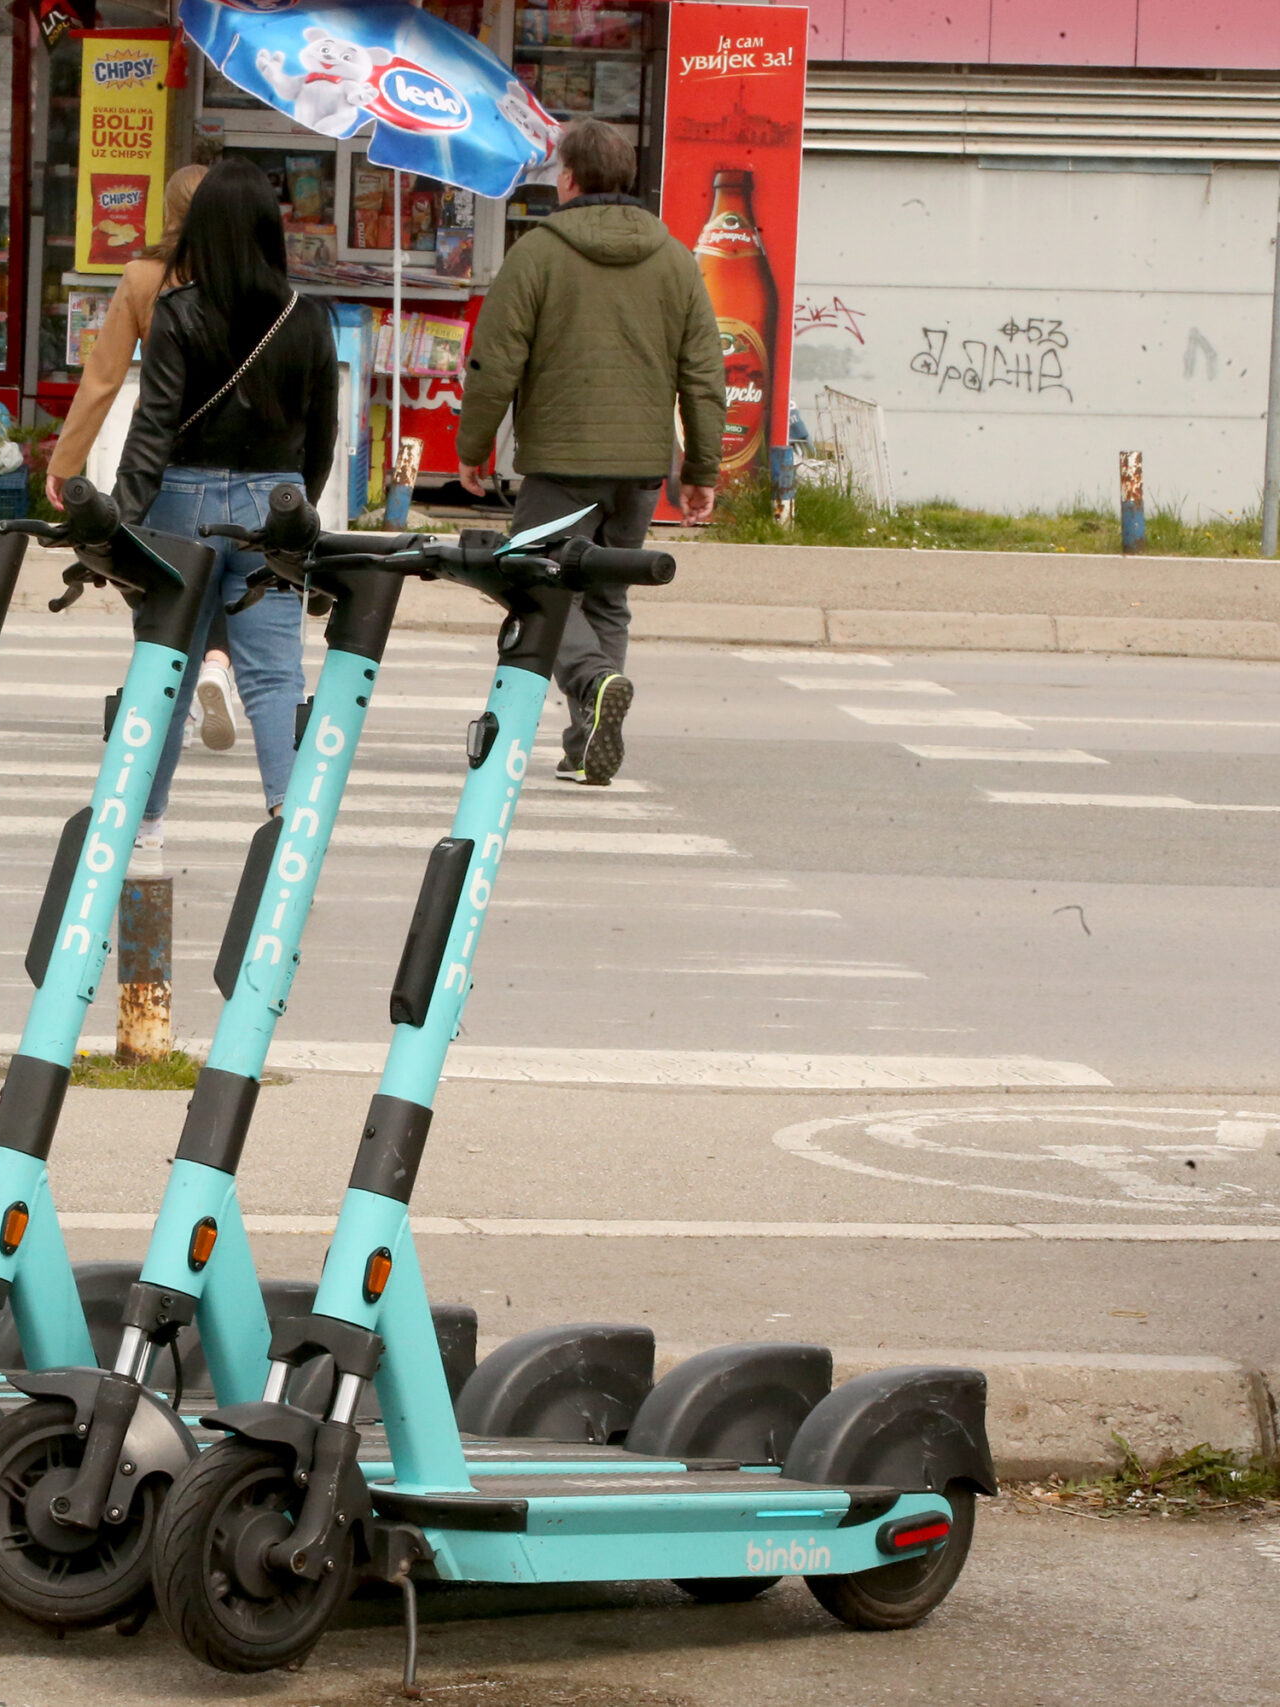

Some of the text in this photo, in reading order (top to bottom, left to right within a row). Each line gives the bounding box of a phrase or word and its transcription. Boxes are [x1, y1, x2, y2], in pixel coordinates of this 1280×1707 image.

[736, 36, 764, 49] сам
[680, 46, 793, 76] увијек за!
[92, 114, 153, 131] BOLJI
[91, 149, 152, 160] UZ CHIPSY
[92, 130, 153, 149] UKUS
[61, 706, 152, 955] binbin
[253, 715, 345, 966] binbin
[443, 738, 528, 995] binbin
[746, 1537, 831, 1573] binbin
